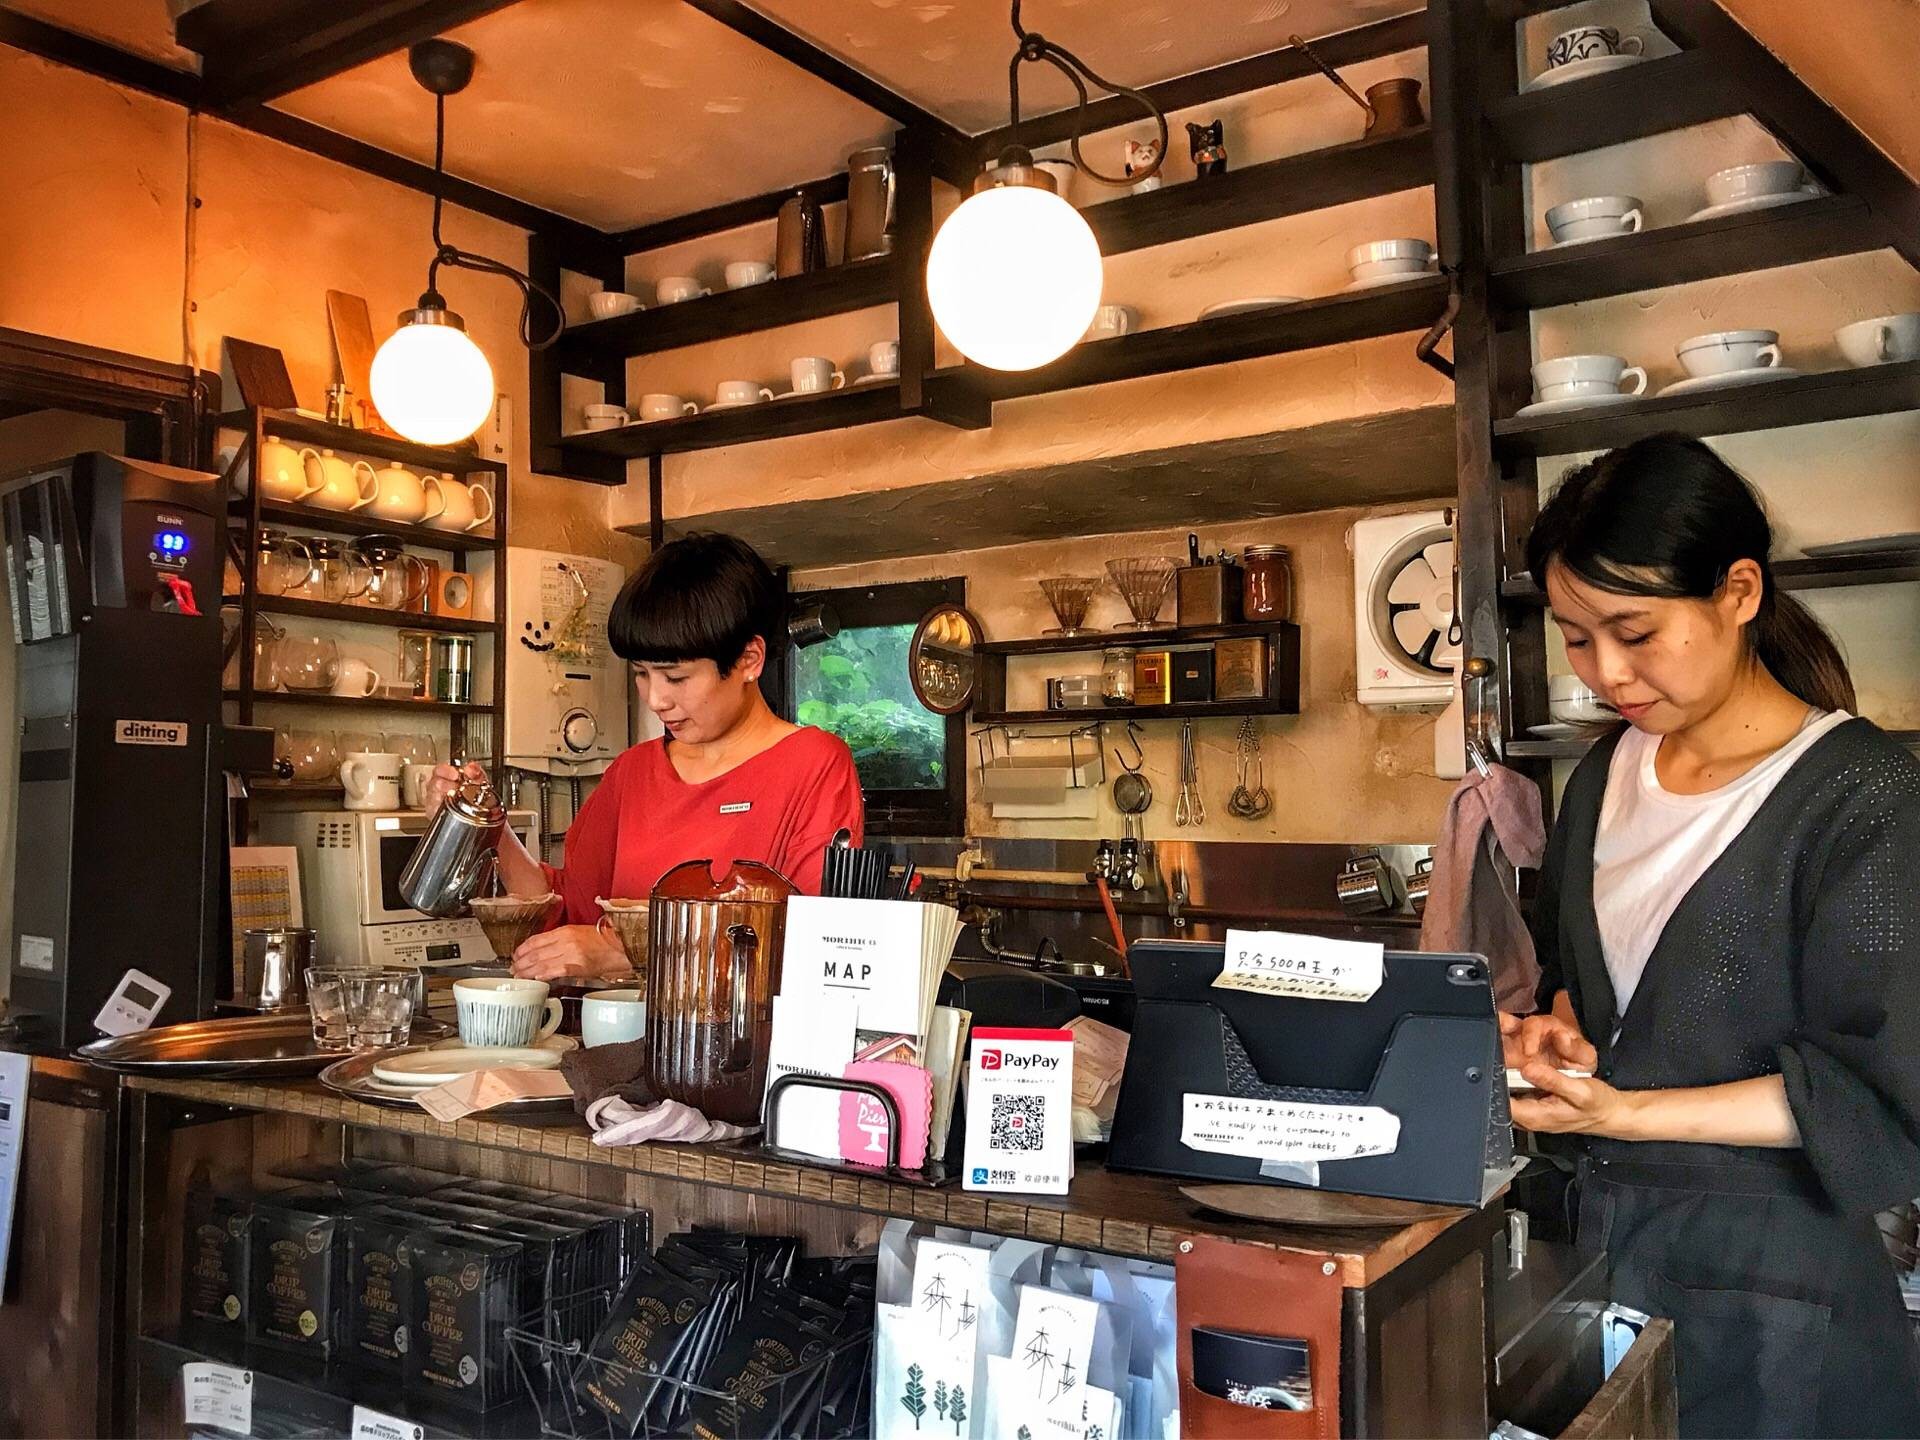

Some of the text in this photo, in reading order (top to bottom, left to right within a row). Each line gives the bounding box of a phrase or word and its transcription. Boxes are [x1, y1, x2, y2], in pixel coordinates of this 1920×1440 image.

[157, 515, 182, 525] BUNN
[123, 722, 178, 742] ditting
[824, 961, 872, 980] MAP
[1005, 1053, 1060, 1070] PayPay
[990, 1169, 1017, 1181] 支付宝
[429, 1311, 456, 1325] DRIP
[422, 1320, 464, 1341] COFFEE
[621, 1328, 648, 1351] DRIP
[611, 1335, 648, 1369] COFFEE
